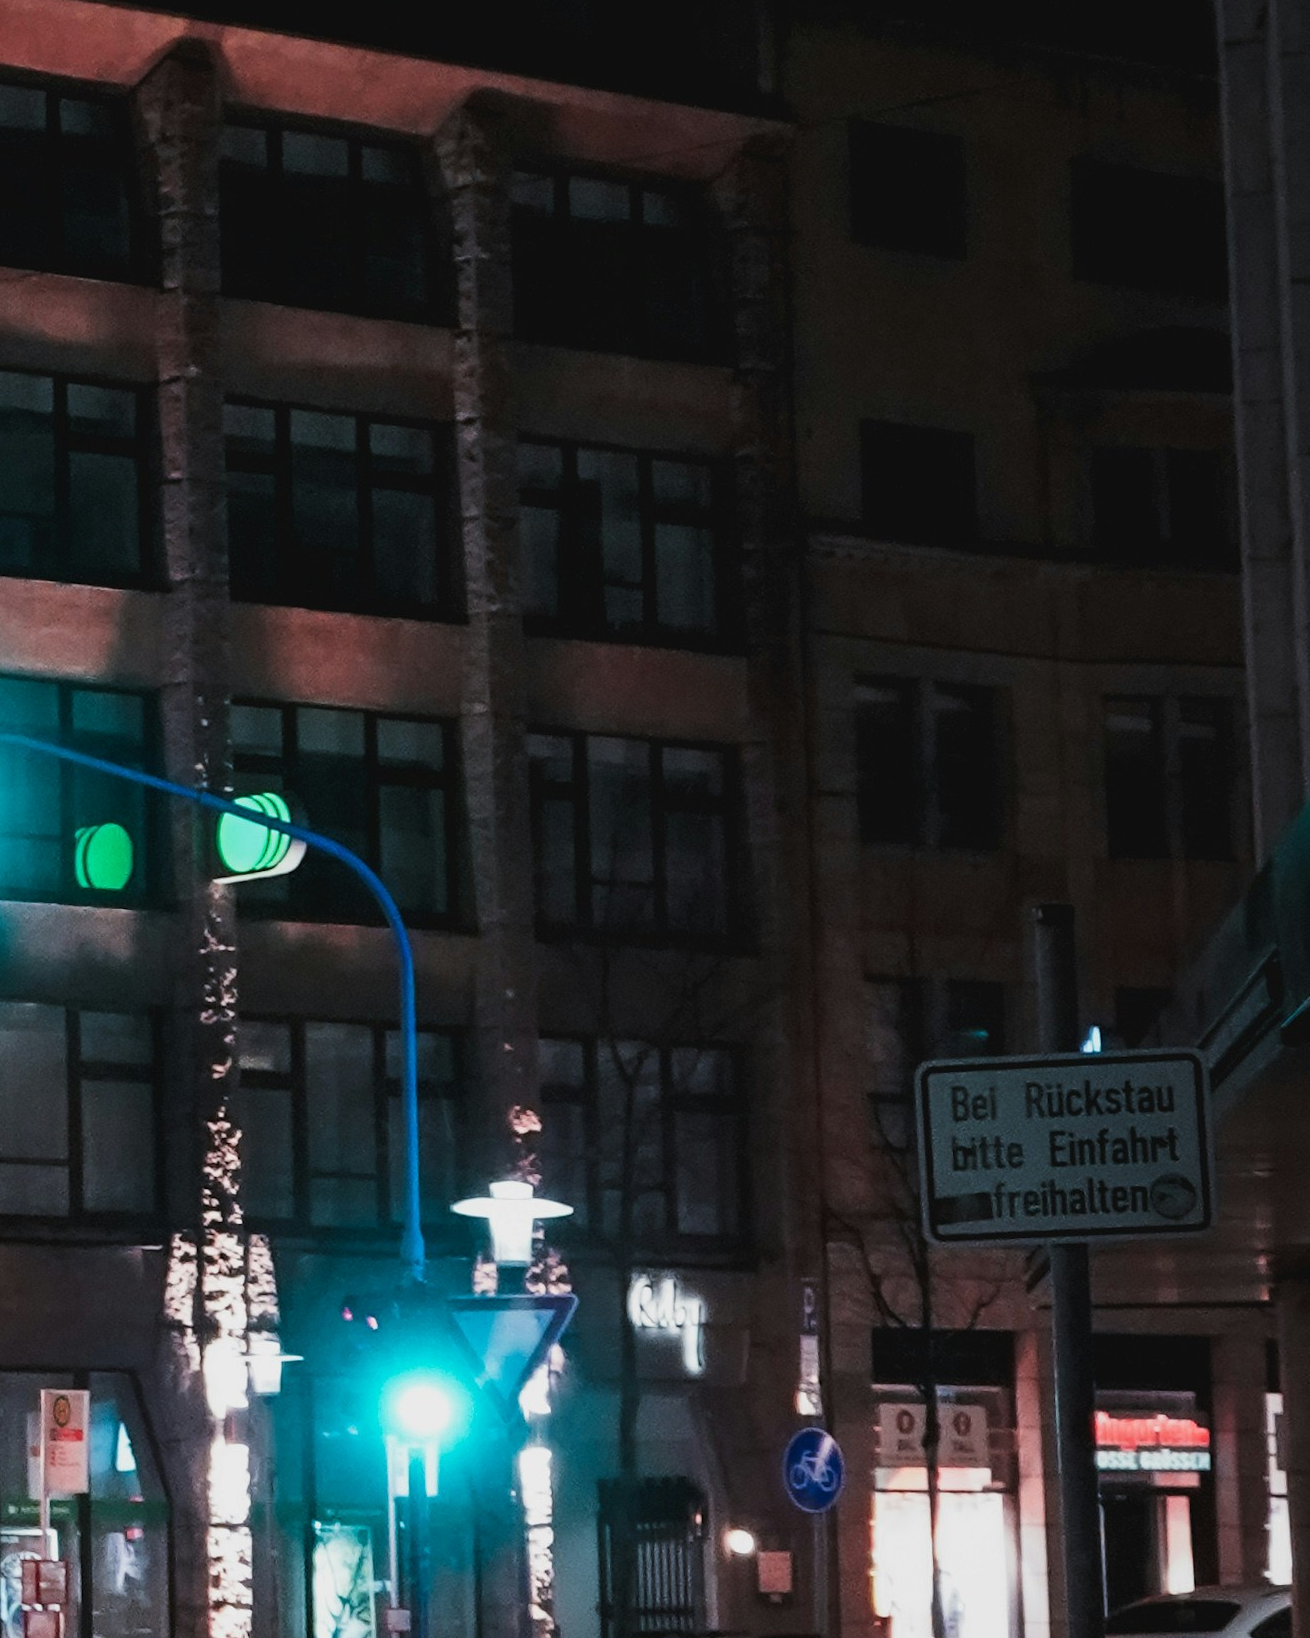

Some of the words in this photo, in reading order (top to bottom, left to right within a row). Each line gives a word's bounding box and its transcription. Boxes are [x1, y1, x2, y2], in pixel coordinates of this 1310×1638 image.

[950, 1084, 998, 1122] Bei
[1024, 1079, 1176, 1120] Rückstau
[951, 1135, 1025, 1172] bitte
[1048, 1125, 1181, 1168] Einfahrt
[992, 1177, 1149, 1219] freihalten
